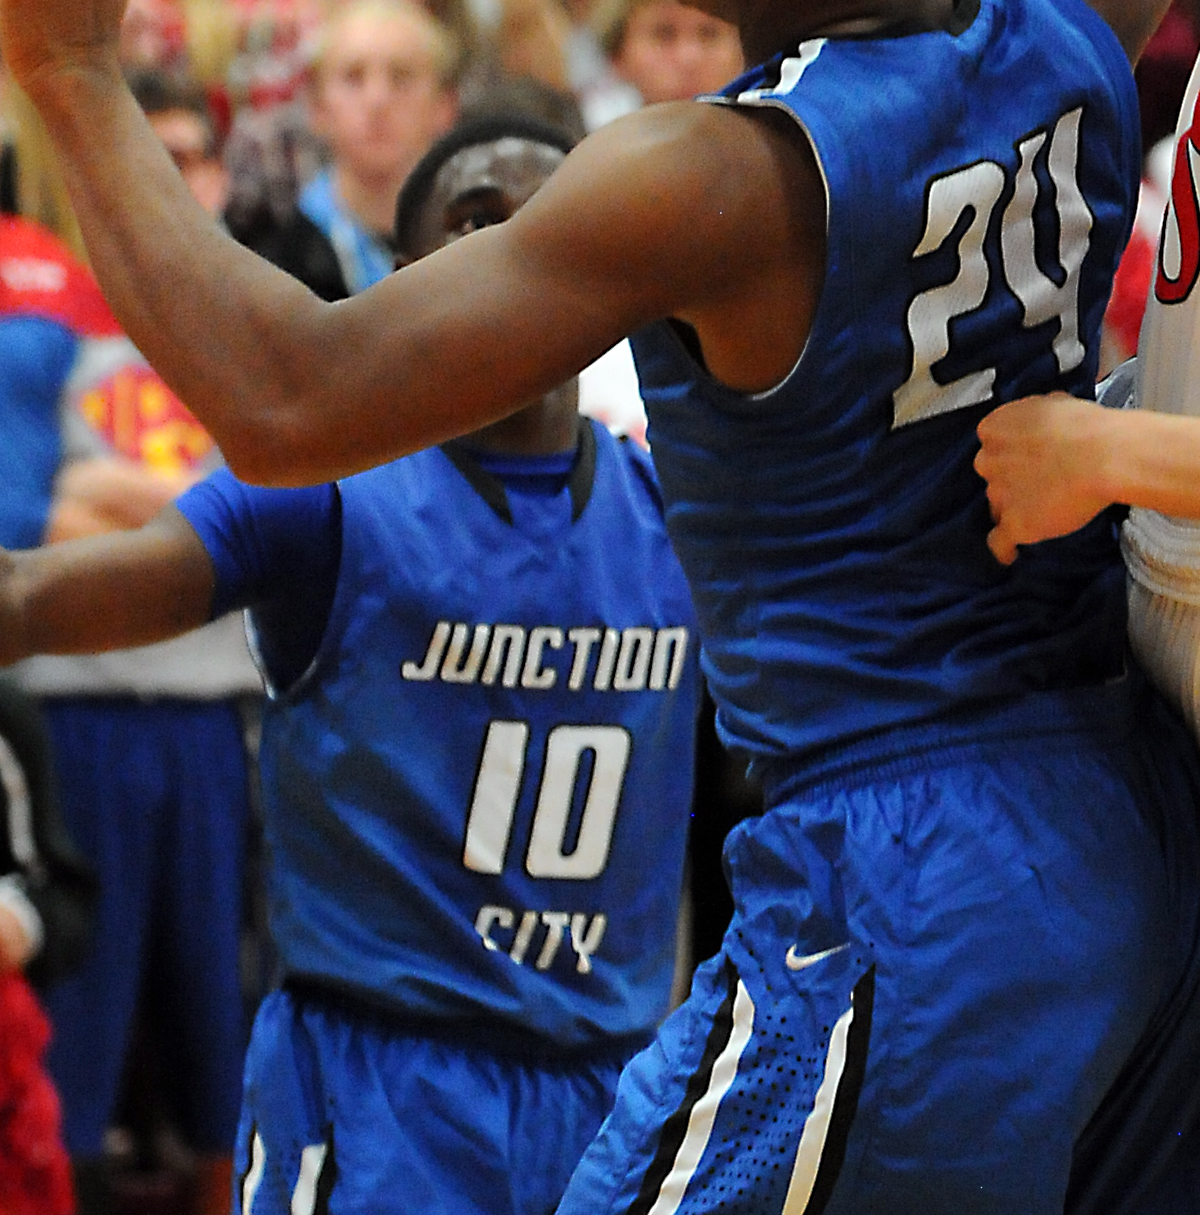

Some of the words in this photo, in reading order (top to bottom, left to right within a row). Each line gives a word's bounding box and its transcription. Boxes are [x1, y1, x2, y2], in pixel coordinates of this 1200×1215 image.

[890, 106, 1094, 431] 24
[401, 620, 688, 692] JUNCTION
[463, 718, 632, 881] 10
[475, 904, 608, 975] CITY
